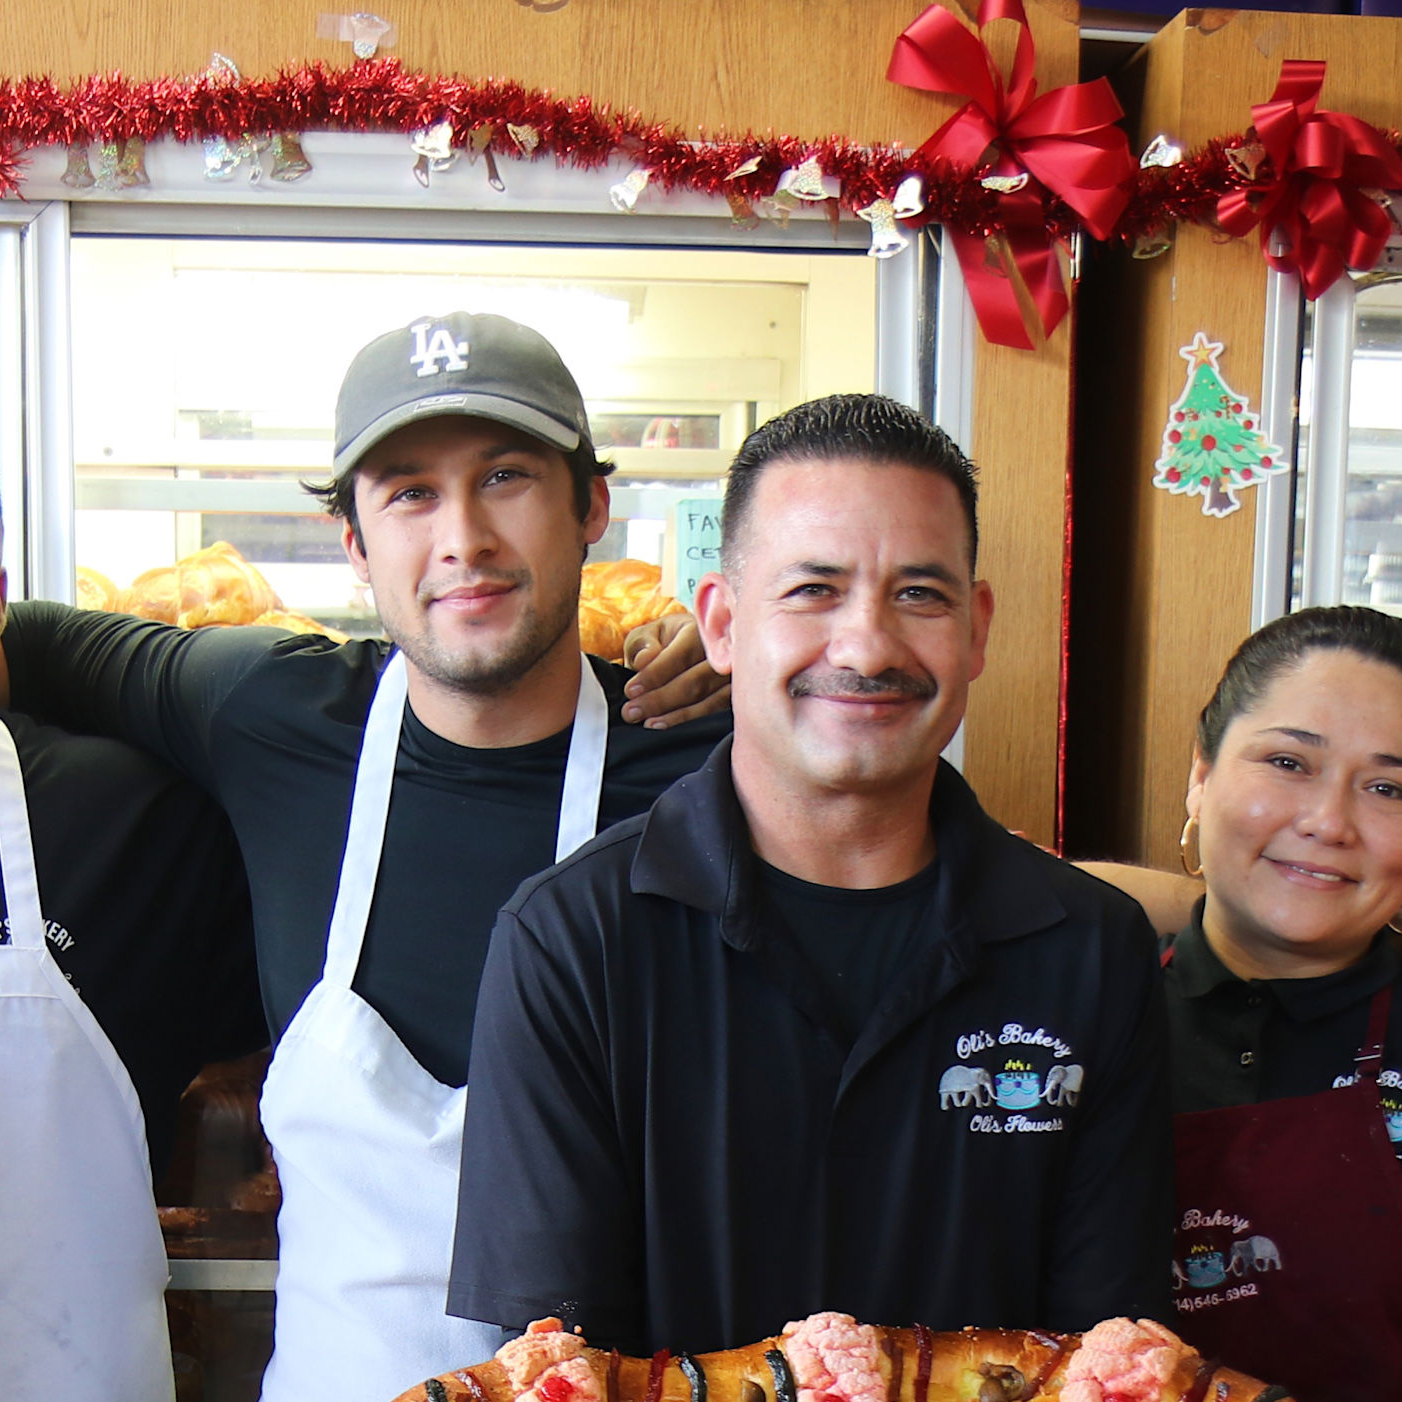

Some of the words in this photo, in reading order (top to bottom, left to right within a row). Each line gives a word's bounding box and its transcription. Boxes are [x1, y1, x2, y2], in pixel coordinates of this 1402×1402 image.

[410, 323, 469, 377] LA
[688, 513, 723, 532] FAV
[42, 918, 76, 952] KERY
[956, 1030, 996, 1060] Oli's
[998, 1023, 1072, 1058] Bakery
[969, 1114, 1002, 1134] Oli's
[1181, 1208, 1250, 1235] Bakery
